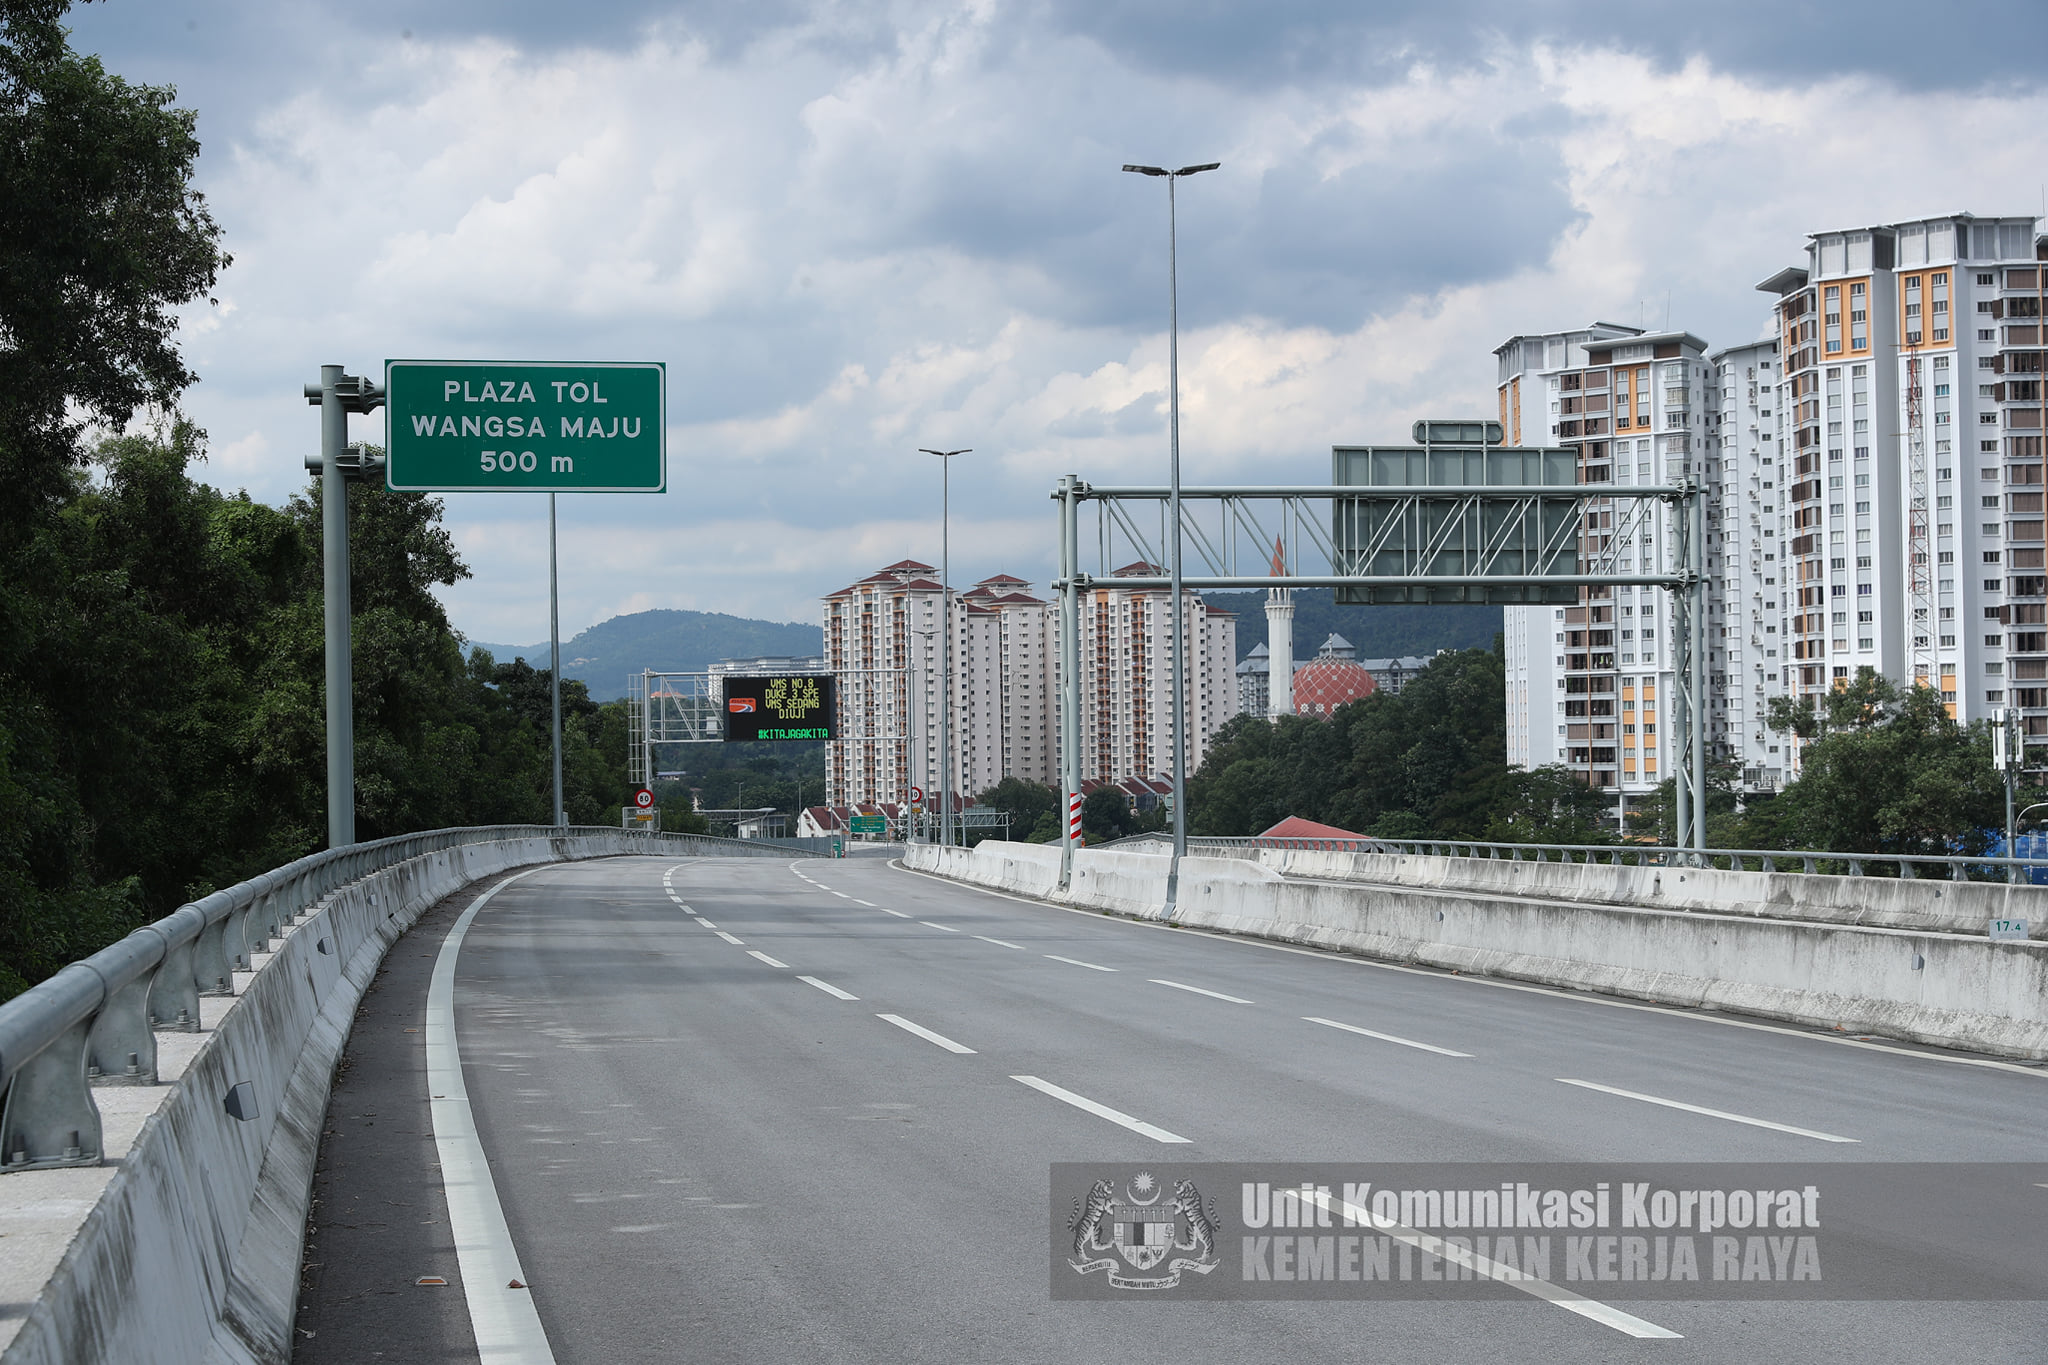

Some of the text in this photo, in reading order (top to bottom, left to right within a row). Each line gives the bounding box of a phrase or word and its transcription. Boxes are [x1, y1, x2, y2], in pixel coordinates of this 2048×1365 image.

[443, 380, 609, 404] PLAZA TOL
[411, 415, 642, 439] WANGSA MAJU
[480, 450, 574, 473] 500 m
[770, 678, 814, 689] VMS NO.8
[765, 688, 819, 699] DUKE 3 SPE
[765, 698, 820, 709] VMS SEDANG
[779, 708, 805, 719] DIUJI
[758, 728, 828, 739] #KITAJAGAKITA
[1996, 921, 2021, 932] 17.4
